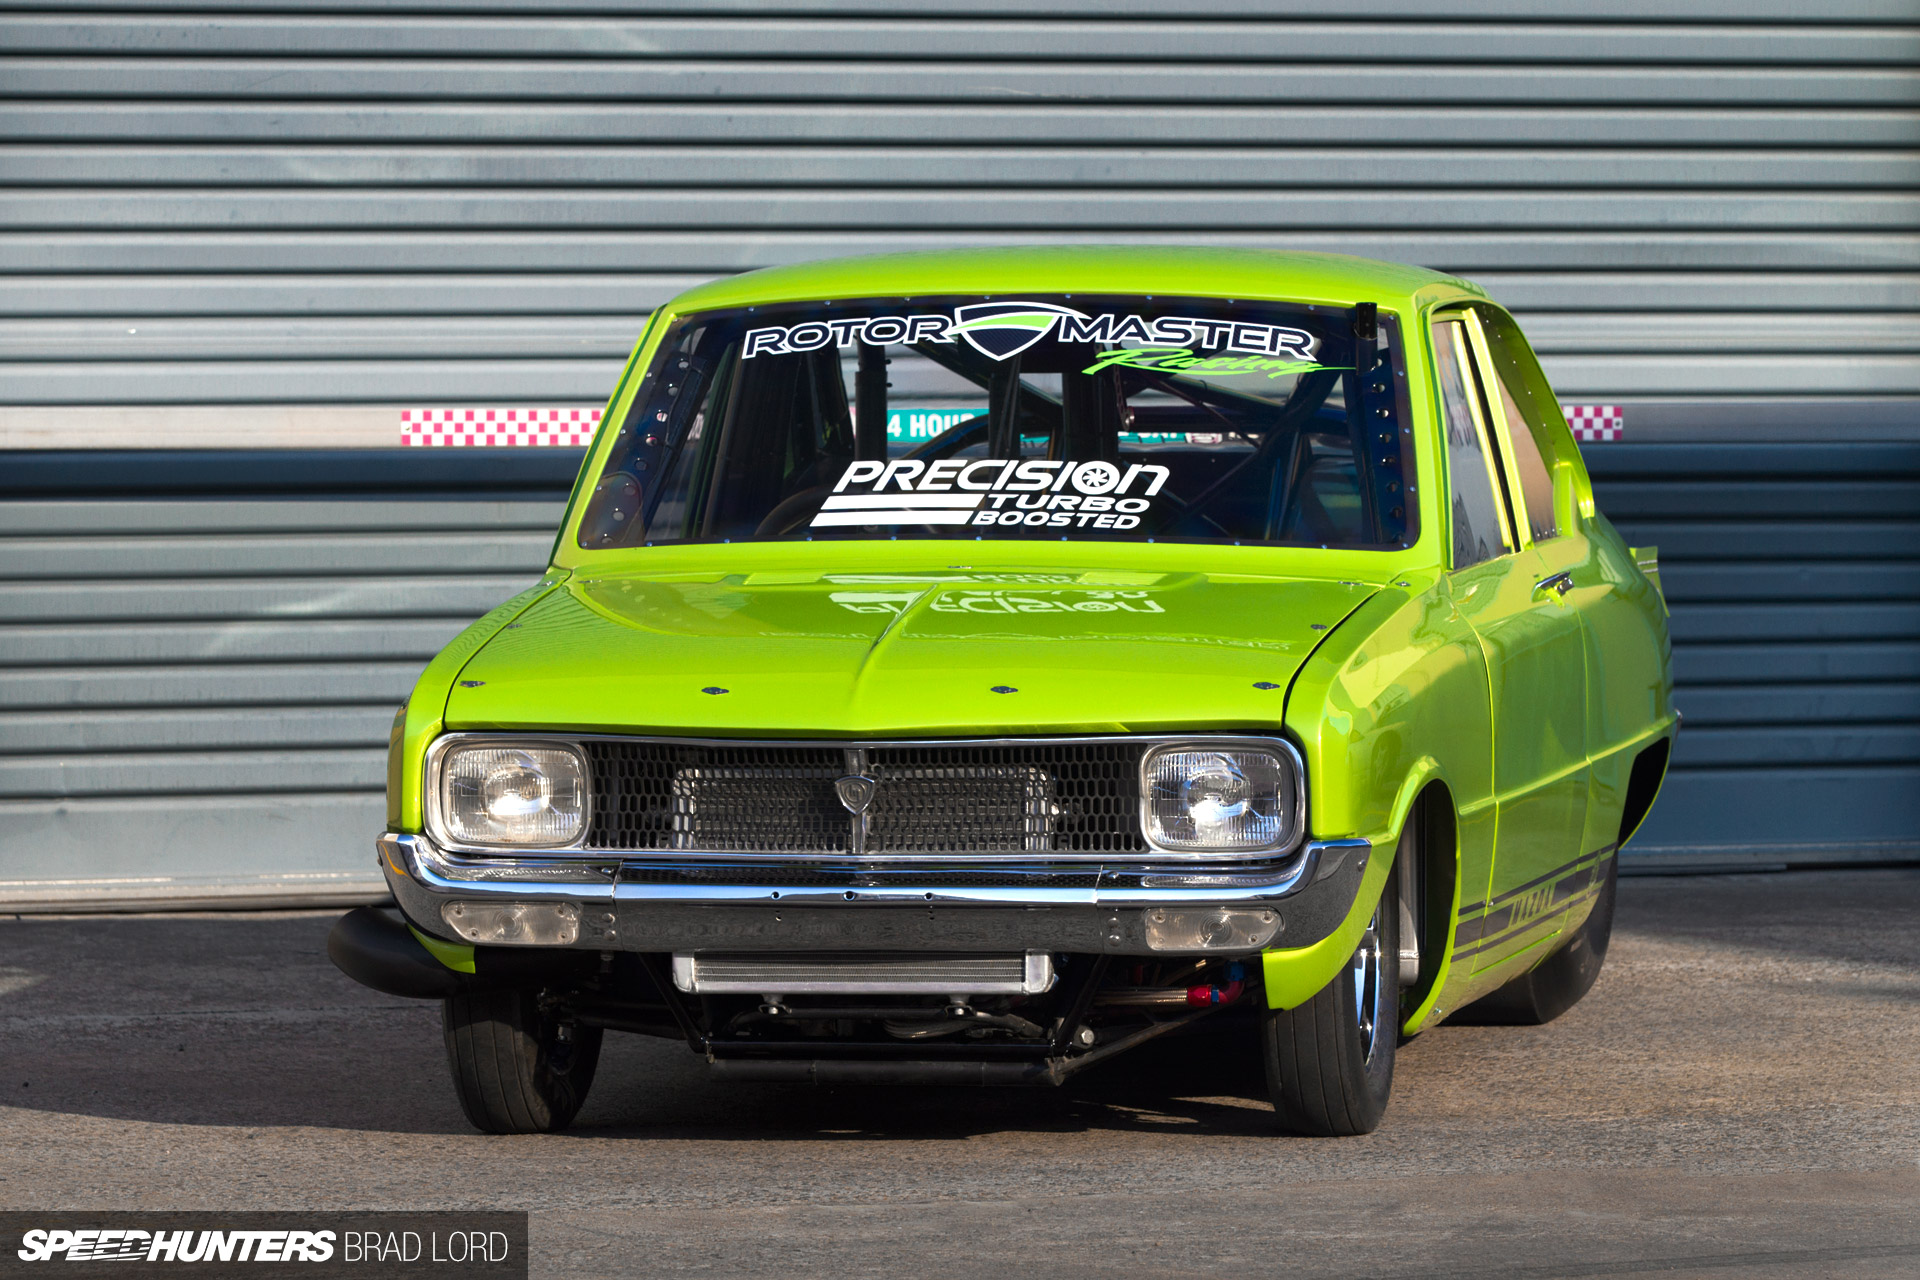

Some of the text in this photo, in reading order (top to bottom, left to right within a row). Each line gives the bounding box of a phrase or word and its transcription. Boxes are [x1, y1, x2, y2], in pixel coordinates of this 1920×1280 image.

[742, 314, 1318, 361] ROTOR MASTER
[1082, 348, 1357, 379] Racing
[988, 493, 1151, 512] TURBO
[971, 511, 1141, 530] BOOSTED
